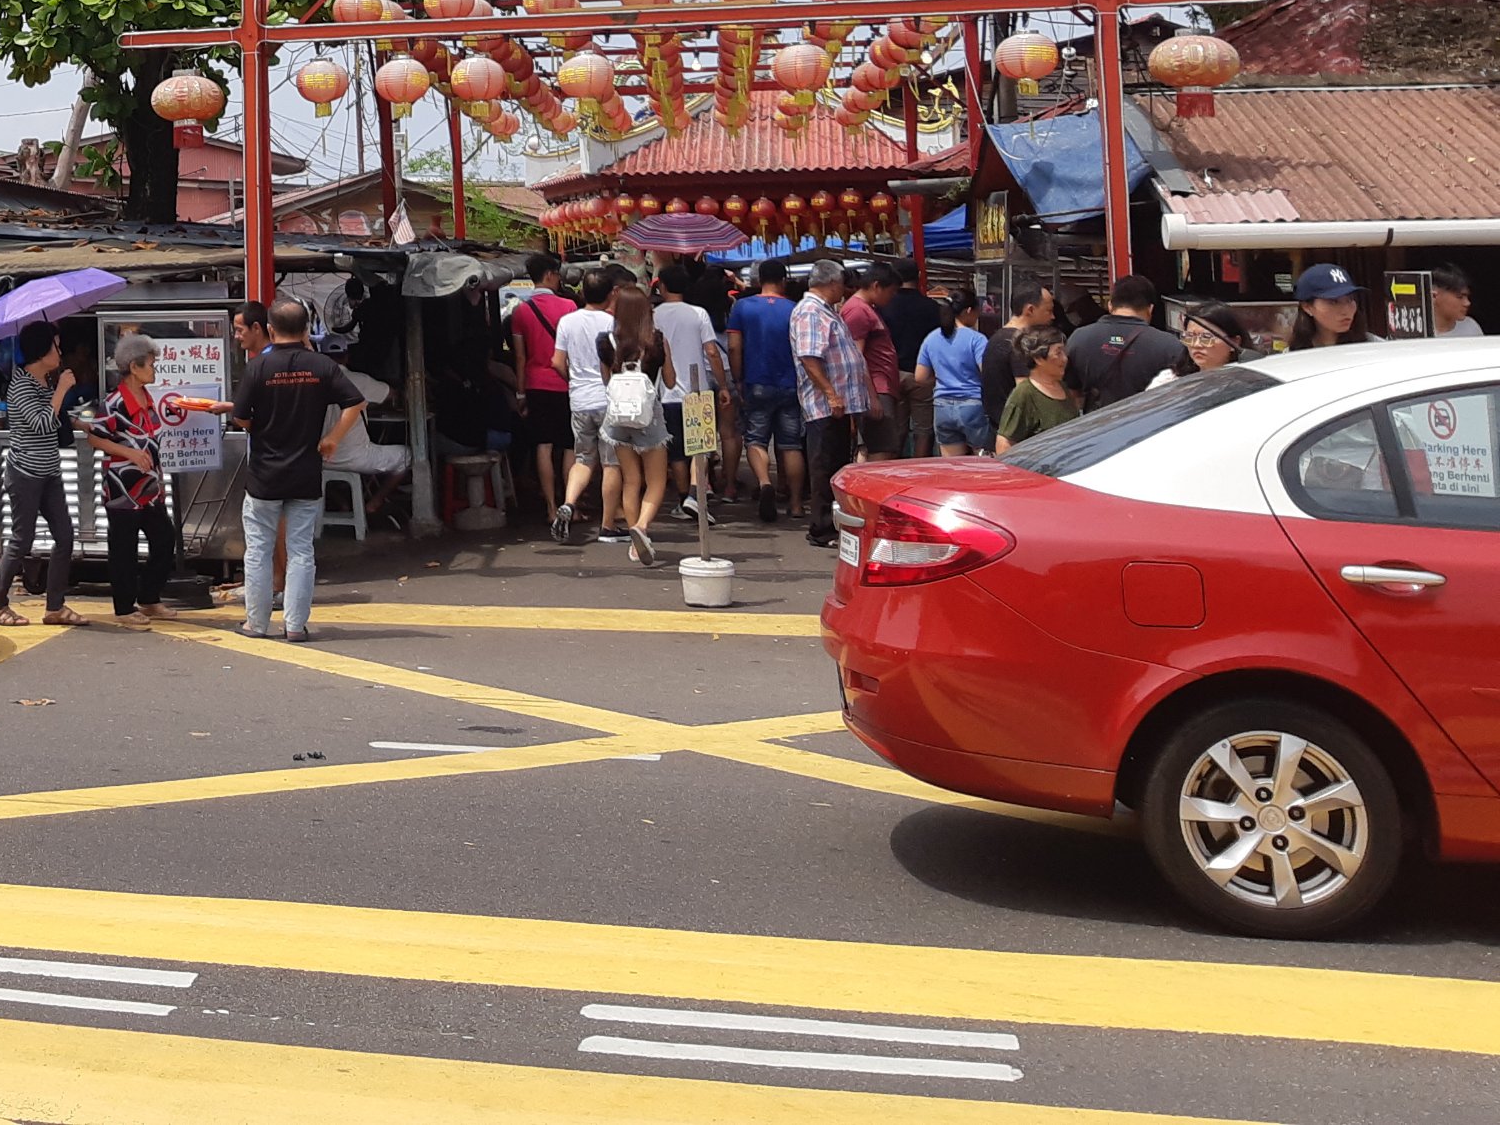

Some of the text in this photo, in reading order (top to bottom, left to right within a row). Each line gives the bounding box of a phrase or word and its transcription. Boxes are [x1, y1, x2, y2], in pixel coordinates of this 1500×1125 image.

[154, 364, 216, 374] KKIEN MEE
[164, 428, 214, 438] rking Here
[177, 448, 216, 457] Berhenti
[1462, 445, 1487, 456] Here
[1447, 471, 1490, 483] Berhenti
[1449, 483, 1459, 491] di
[1462, 484, 1480, 493] sini
